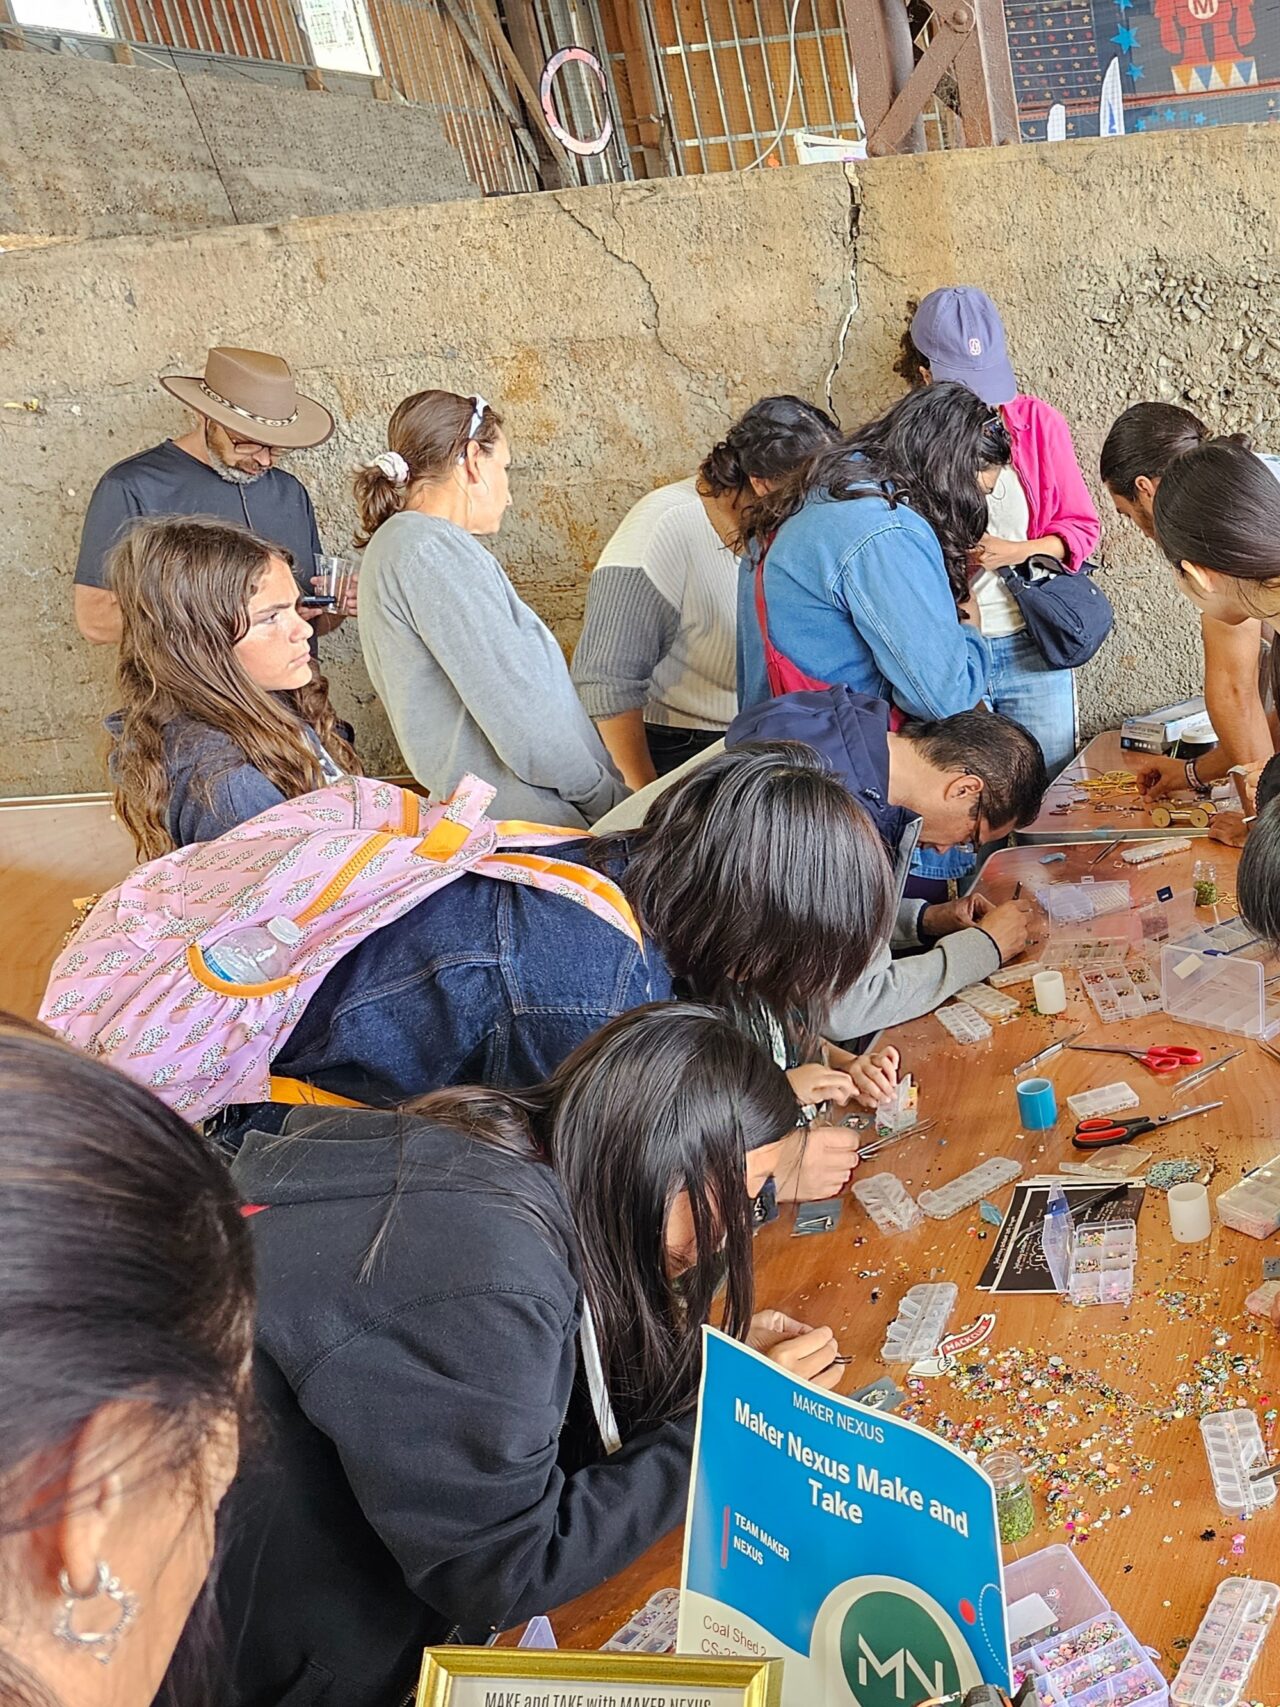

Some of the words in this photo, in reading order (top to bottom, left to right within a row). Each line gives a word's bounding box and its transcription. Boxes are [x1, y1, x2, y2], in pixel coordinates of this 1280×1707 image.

[792, 1391, 834, 1425] MAKER
[836, 1412, 885, 1444] NEXUS
[735, 1397, 784, 1450] Maker
[787, 1431, 851, 1484] Nexus
[856, 1463, 924, 1511] Make
[929, 1499, 969, 1538] and
[808, 1477, 864, 1525] Take
[733, 1535, 764, 1565] NEXUS
[734, 1511, 759, 1539] TEAM
[760, 1529, 790, 1562] MAKER
[703, 1615, 730, 1638] Coal
[732, 1628, 759, 1655] Shed
[485, 1692, 521, 1707] MAKE
[525, 1694, 549, 1707] and
[553, 1694, 583, 1707] TAKE
[586, 1695, 616, 1707] with
